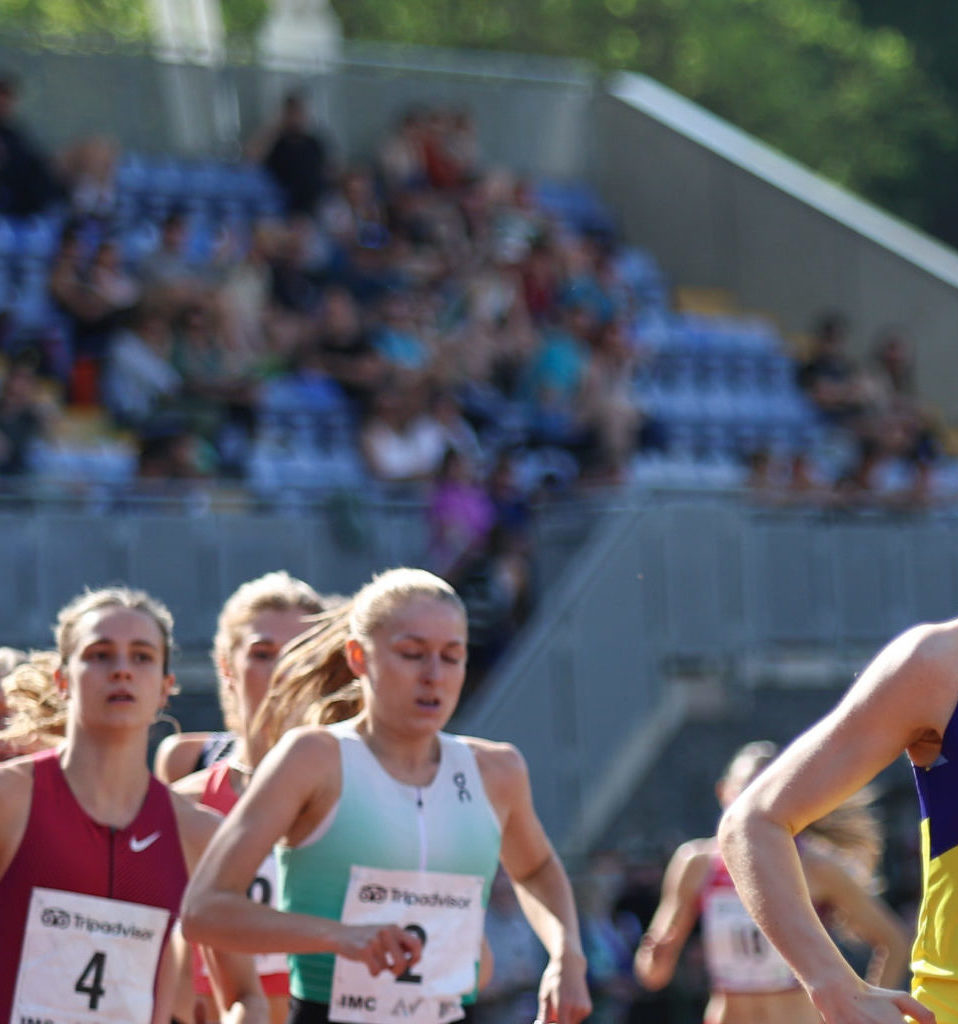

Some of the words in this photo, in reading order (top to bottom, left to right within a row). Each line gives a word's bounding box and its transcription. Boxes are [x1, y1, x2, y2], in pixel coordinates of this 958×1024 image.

[391, 887, 472, 910] Tripadvisor
[74, 913, 154, 941] Tripadvisor
[395, 924, 428, 984] 2
[75, 951, 106, 1011] 4
[340, 994, 377, 1012] IMC
